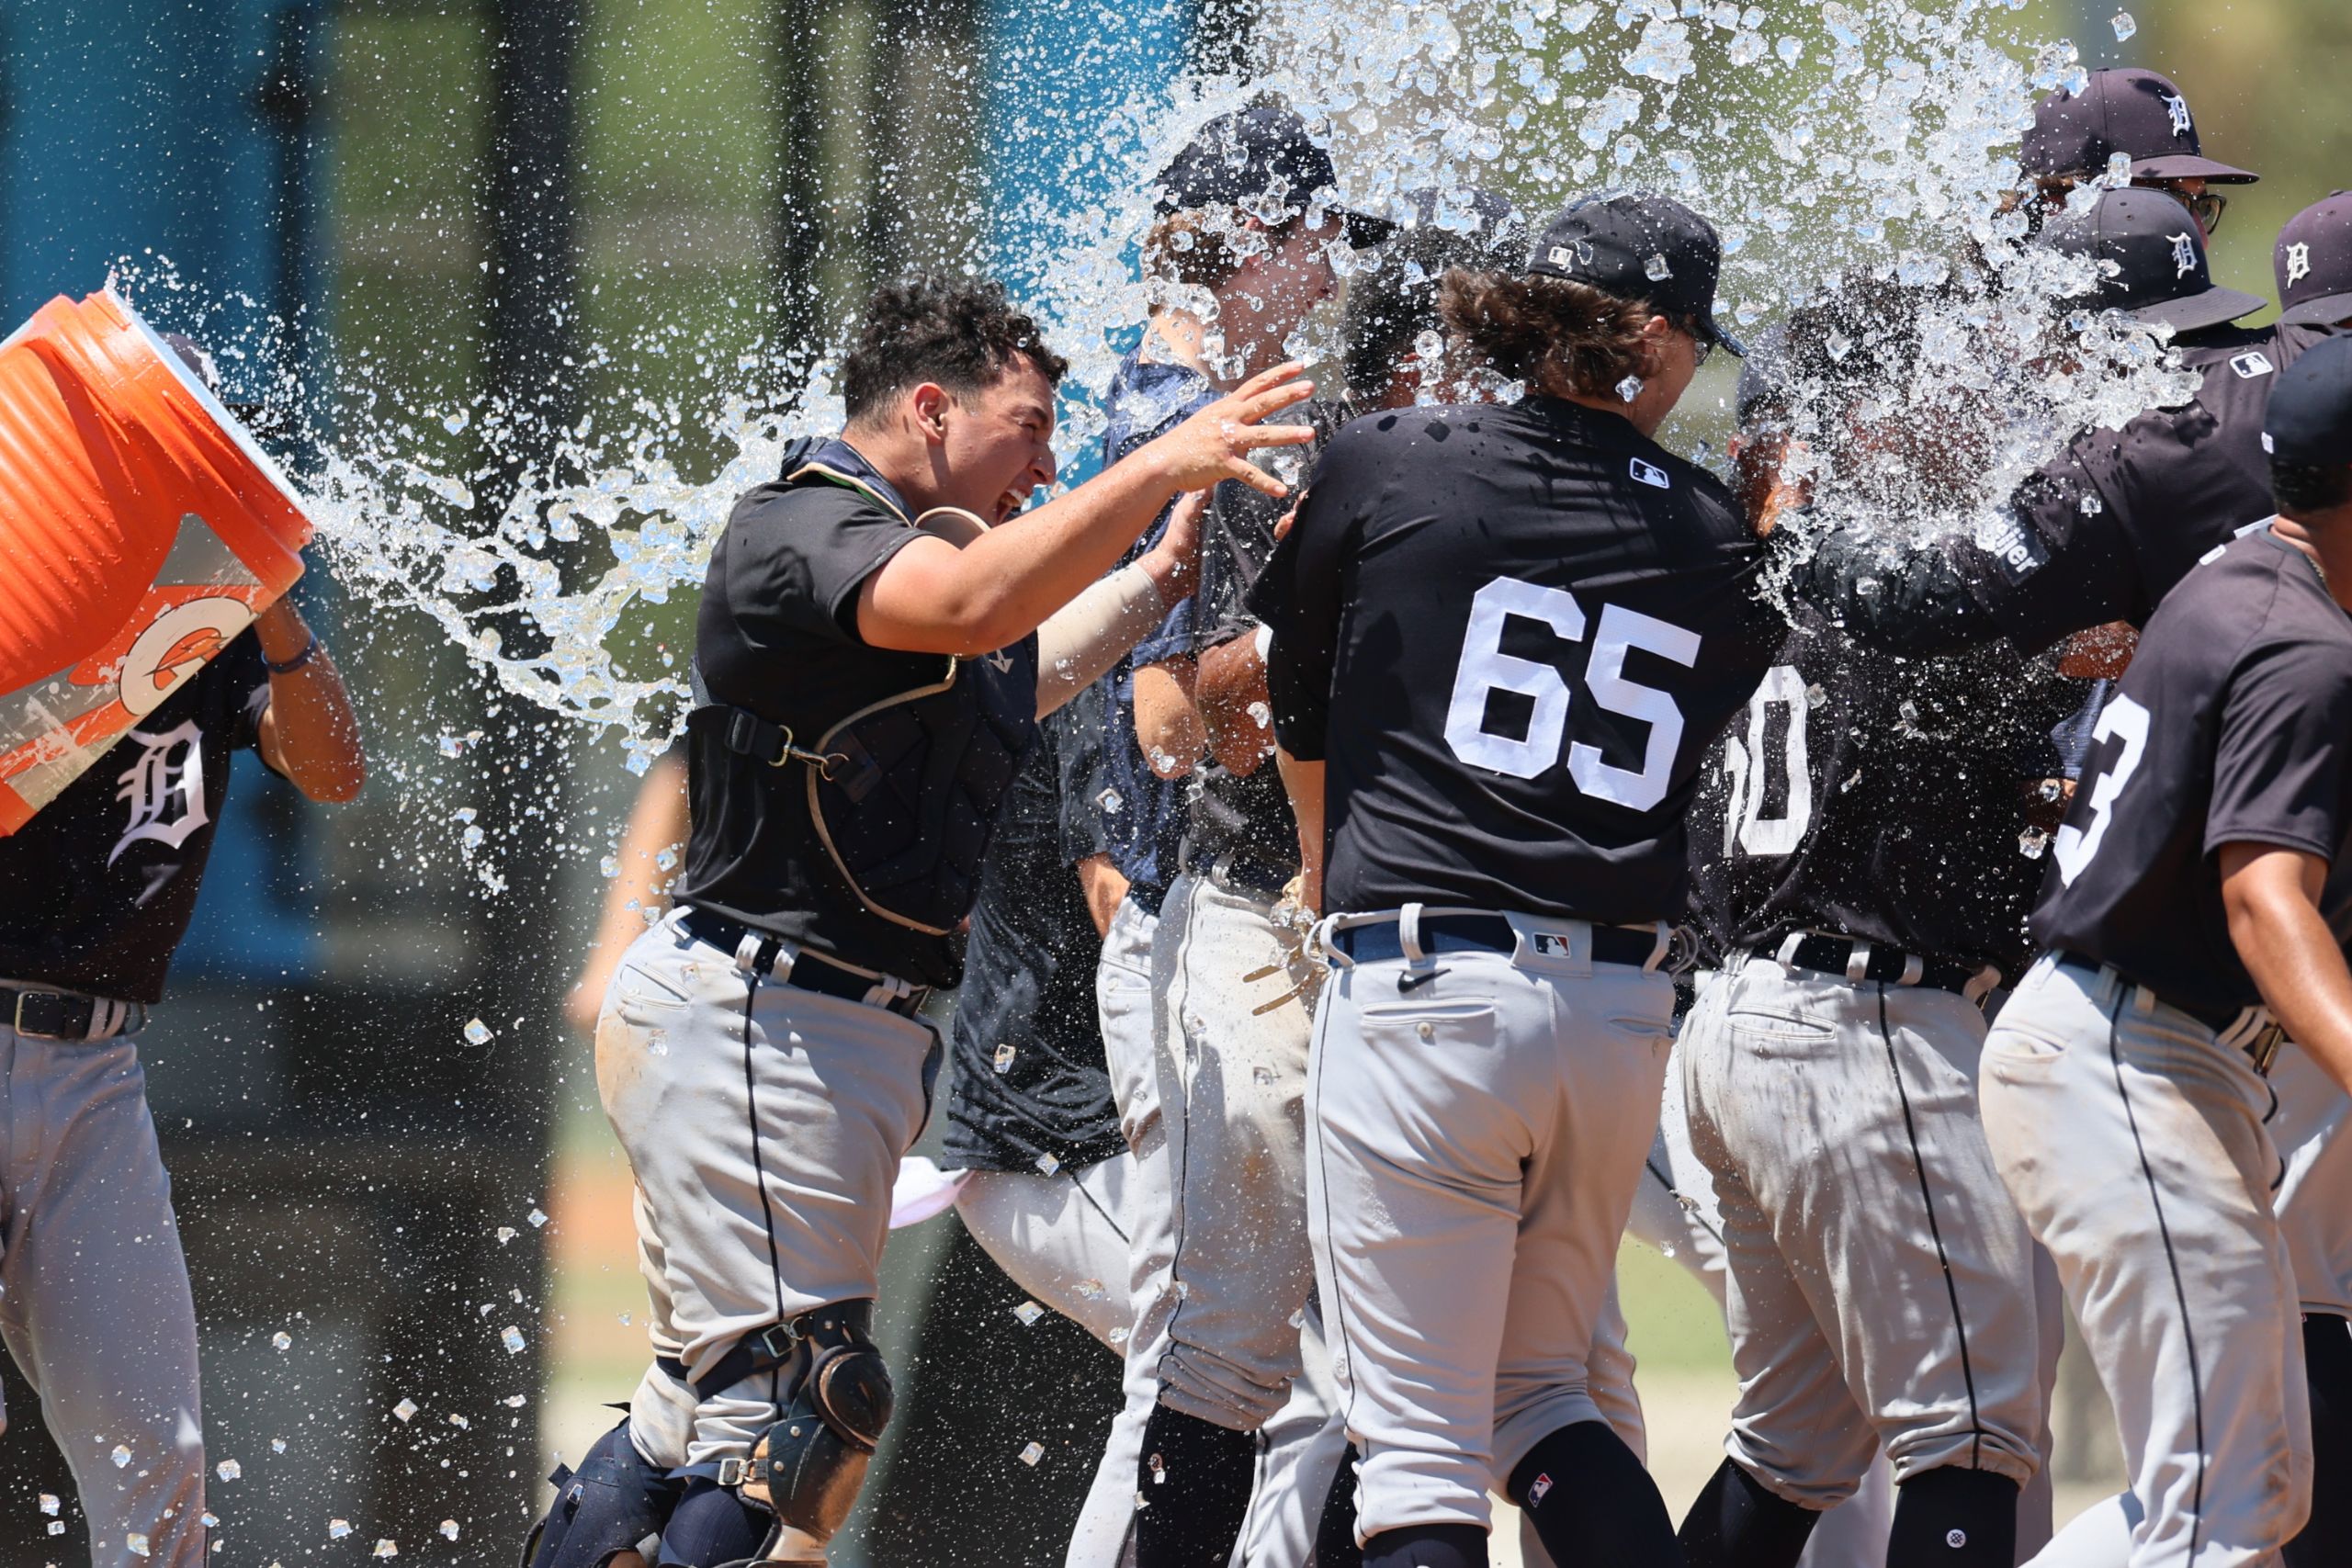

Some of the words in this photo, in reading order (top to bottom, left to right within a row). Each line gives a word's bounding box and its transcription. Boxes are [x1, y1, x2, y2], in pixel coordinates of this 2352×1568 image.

[2286, 242, 2311, 288] D
[1443, 575, 1702, 813] 65
[107, 717, 210, 869] D
[2052, 693, 2151, 889] 3
